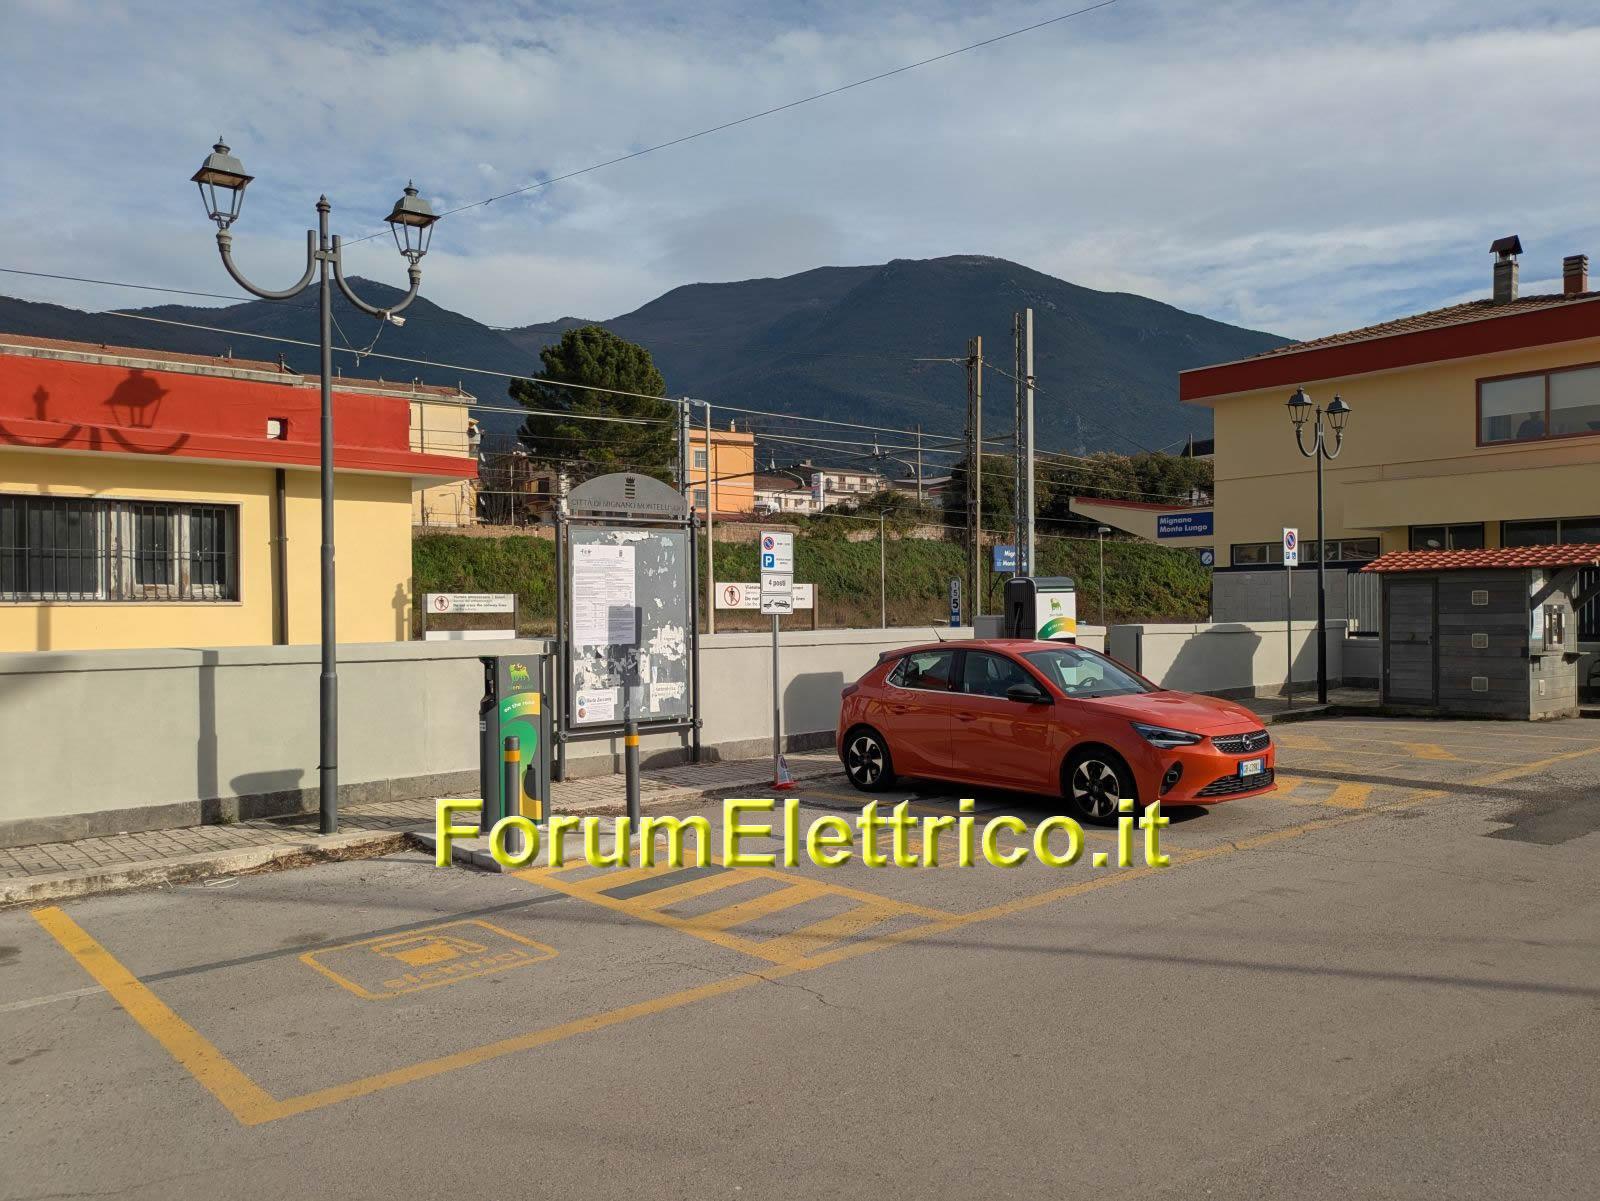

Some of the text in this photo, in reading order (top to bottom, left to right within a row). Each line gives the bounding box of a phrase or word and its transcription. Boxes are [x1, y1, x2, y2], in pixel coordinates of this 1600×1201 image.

[1160, 517, 1192, 525] Mignano
[1185, 524, 1208, 532] Lungo
[952, 599, 959, 609] 5
